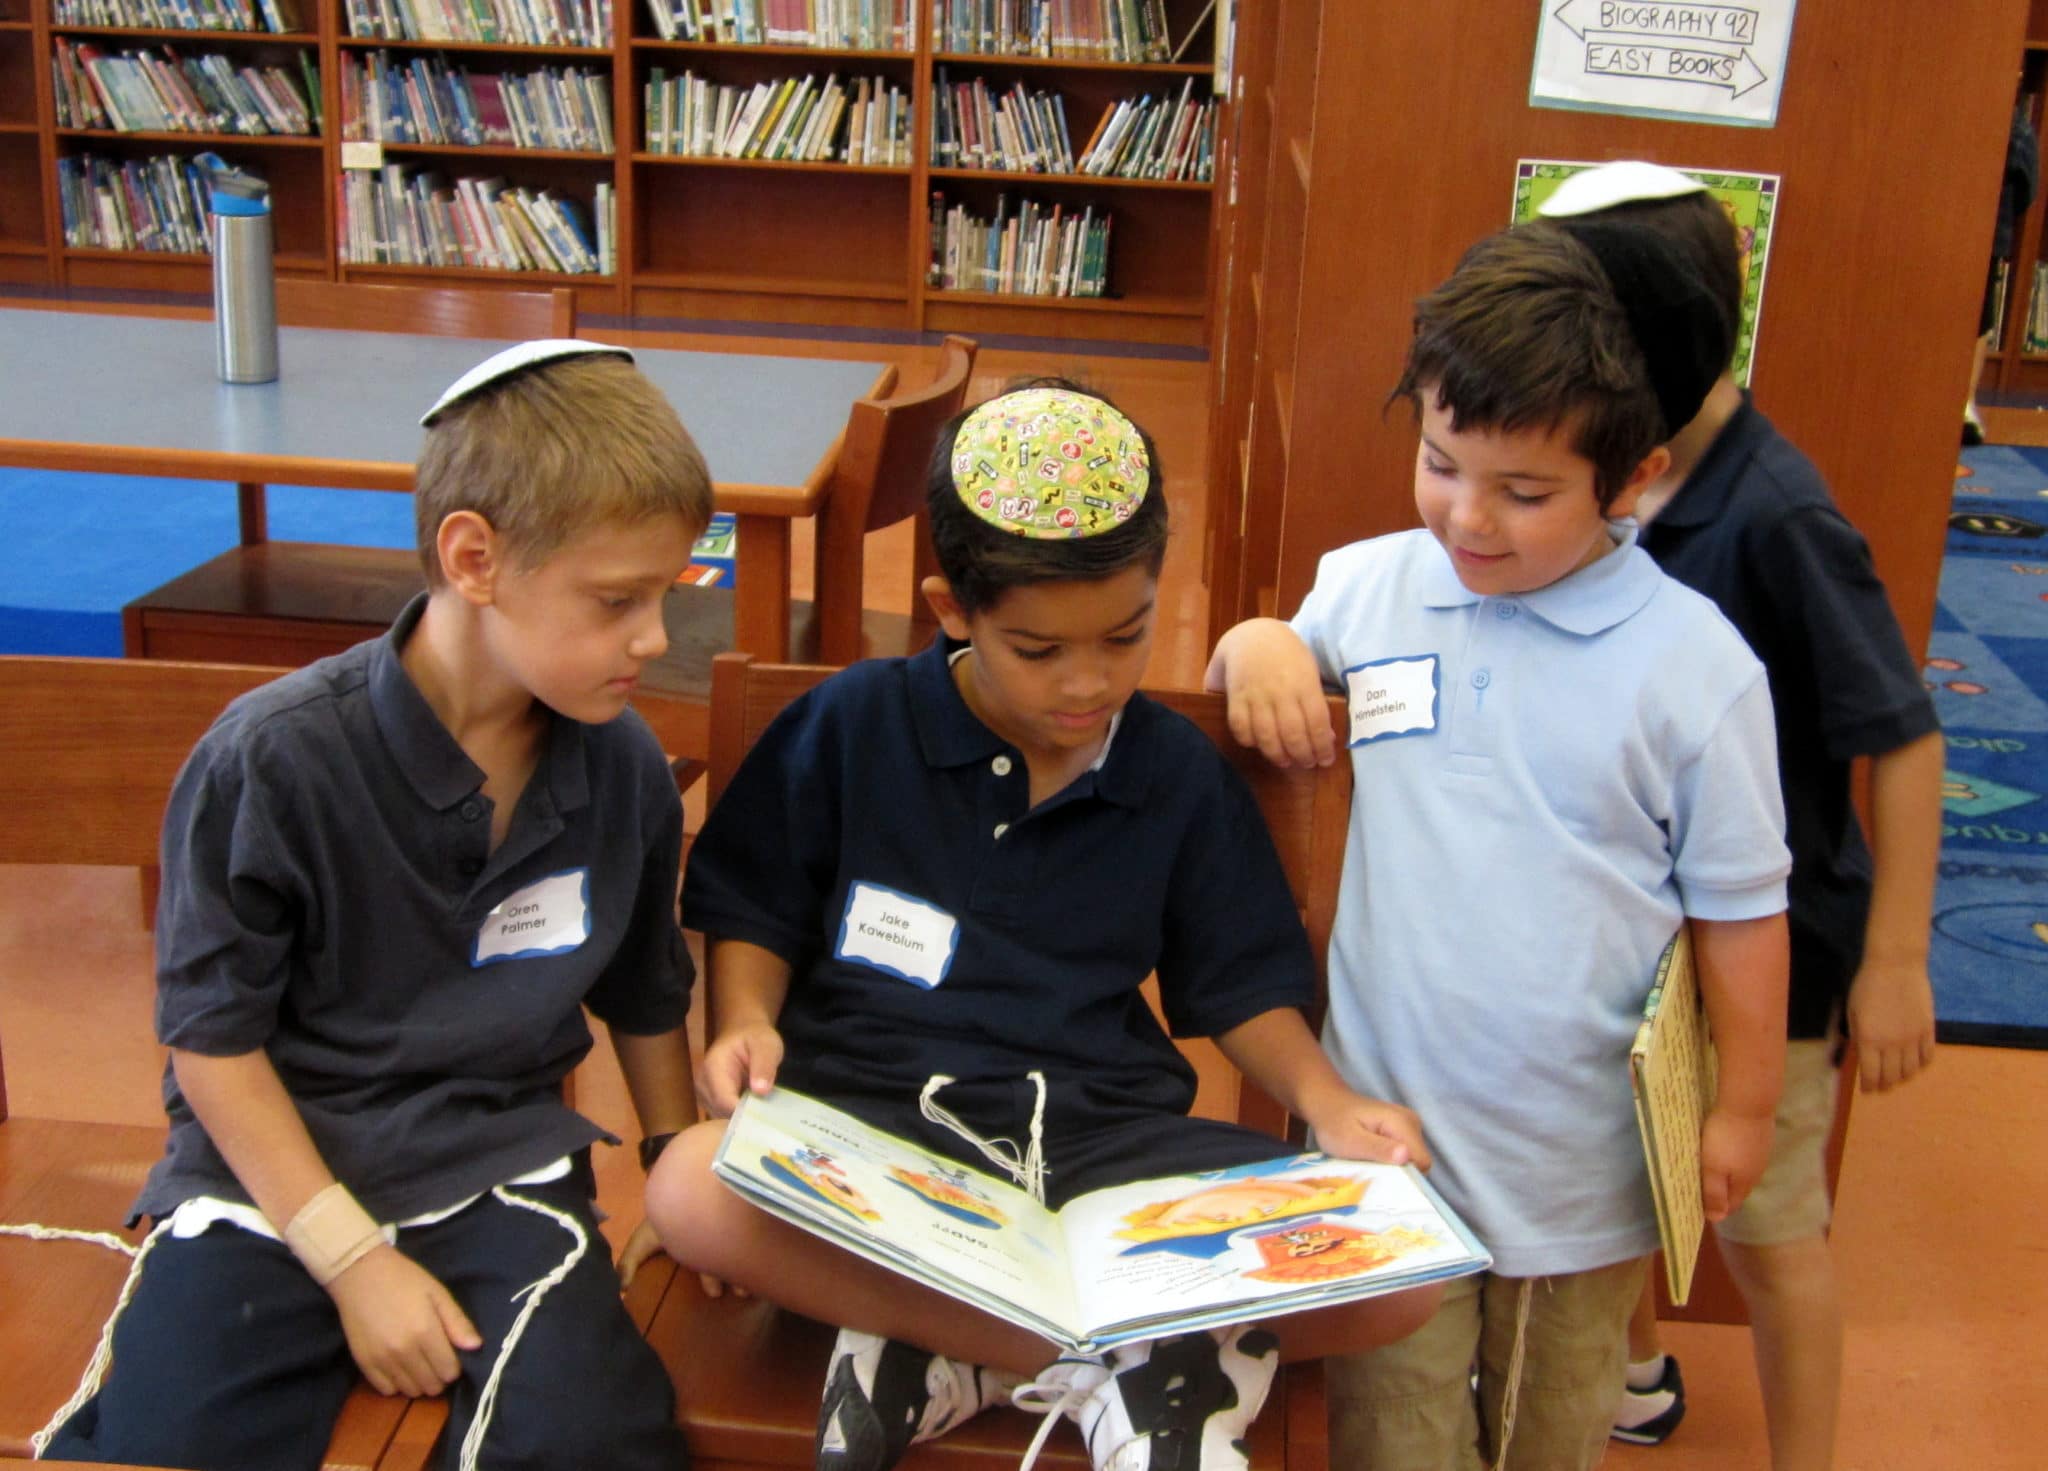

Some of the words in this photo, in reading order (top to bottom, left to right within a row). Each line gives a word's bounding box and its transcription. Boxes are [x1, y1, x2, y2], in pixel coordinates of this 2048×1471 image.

[1600, 6, 1718, 37] BIOGRAPHY
[1723, 13, 1750, 39] 92
[1588, 47, 1653, 71] EASY
[1668, 52, 1735, 81] BOOKS
[1366, 688, 1387, 702] Dan
[507, 902, 540, 918] Oren
[501, 917, 547, 936] Palmer
[879, 911, 910, 930] Jake
